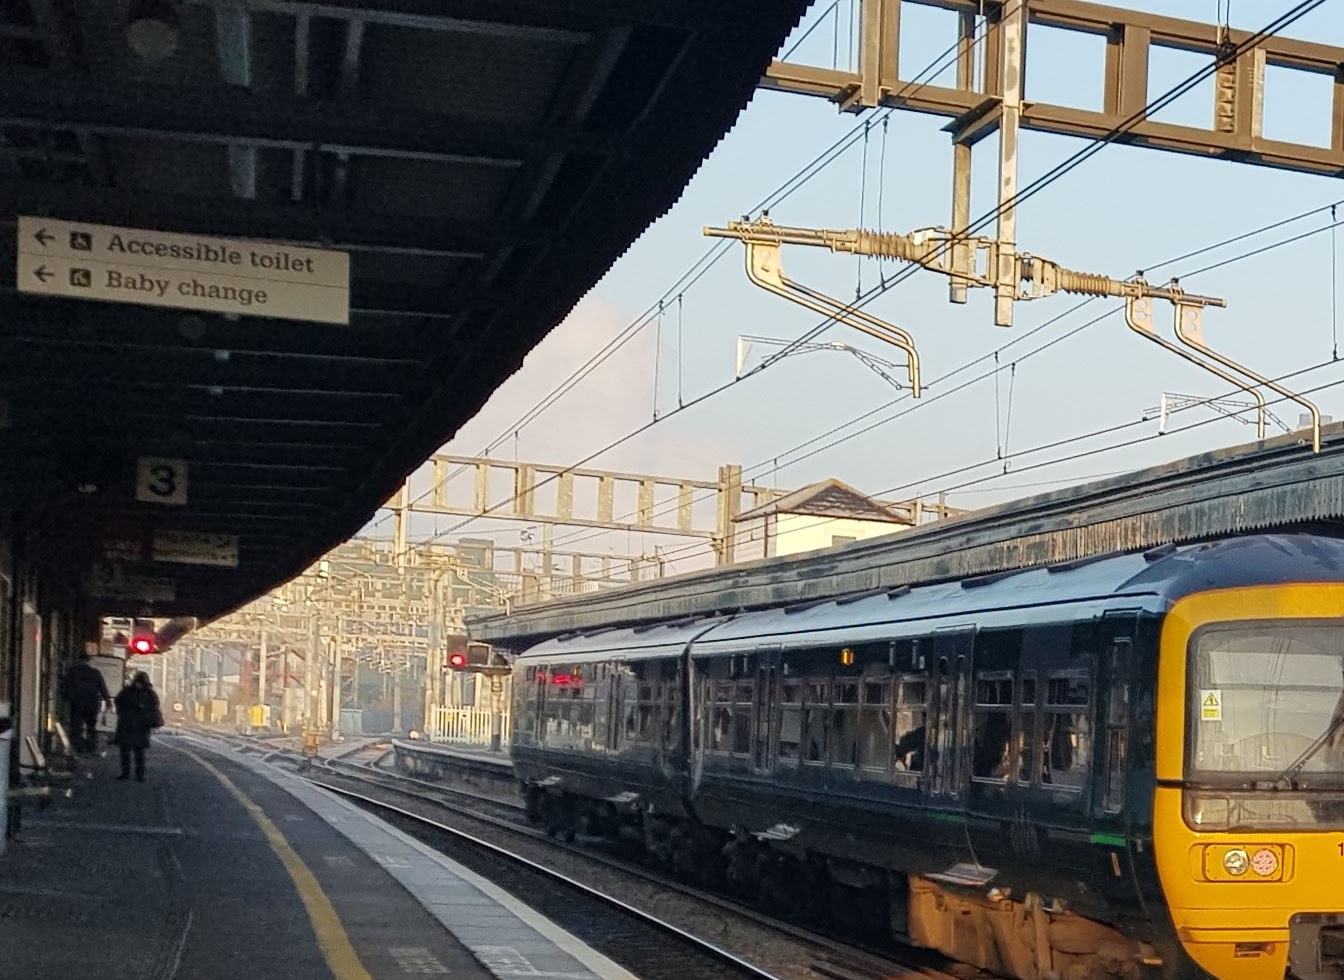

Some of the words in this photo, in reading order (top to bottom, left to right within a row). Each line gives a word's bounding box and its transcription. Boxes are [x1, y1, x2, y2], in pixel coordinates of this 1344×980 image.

[107, 233, 241, 265] Accessible
[250, 251, 314, 273] toilet
[105, 269, 170, 297] Baby
[177, 278, 268, 306] change
[149, 465, 177, 496] 3
